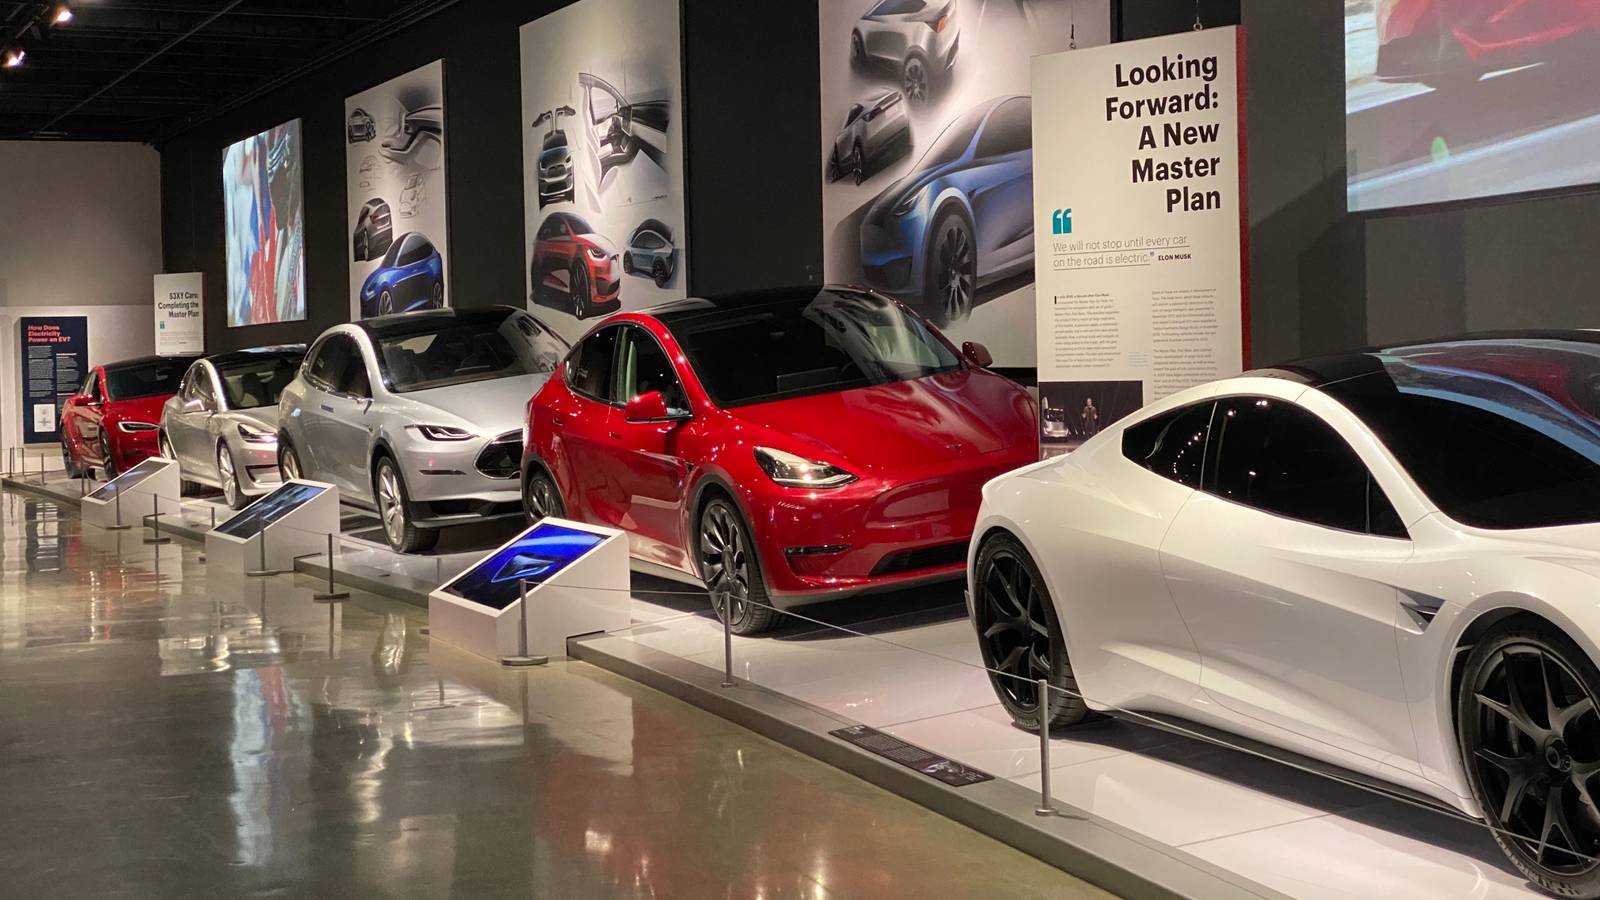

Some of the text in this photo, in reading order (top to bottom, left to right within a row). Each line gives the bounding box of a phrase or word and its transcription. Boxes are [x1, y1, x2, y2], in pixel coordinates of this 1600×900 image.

[1115, 53, 1218, 87] Looking
[1106, 83, 1219, 121] Forward:
[1138, 121, 1220, 150] A New
[1131, 156, 1221, 183] Master
[1166, 186, 1221, 213] Plan
[1053, 234, 1187, 252] We will not stop until every car
[1053, 258, 1065, 268] on
[1067, 255, 1082, 267] the
[1083, 255, 1104, 266] road
[1106, 255, 1113, 264] is
[158, 302, 189, 310] Completing
[169, 292, 184, 300] S3XY
